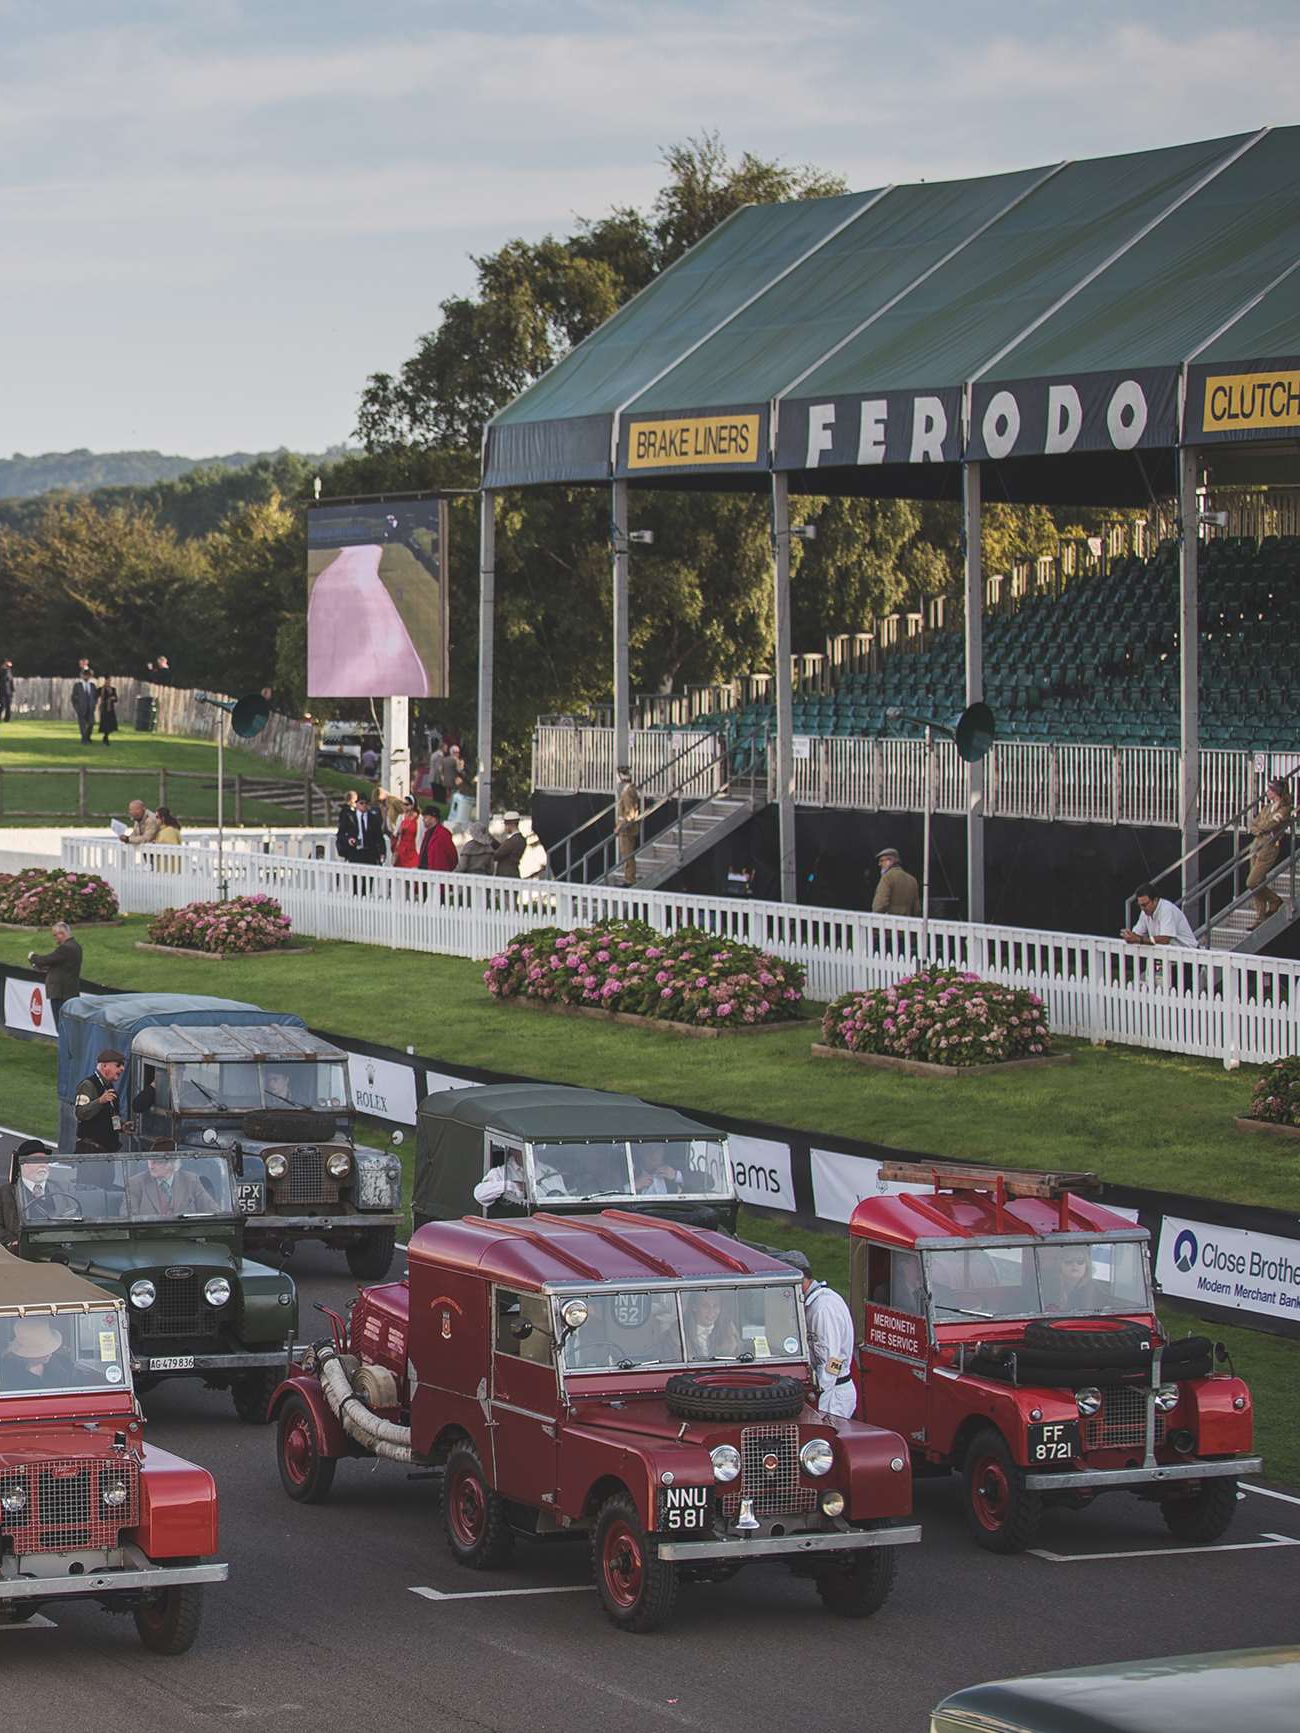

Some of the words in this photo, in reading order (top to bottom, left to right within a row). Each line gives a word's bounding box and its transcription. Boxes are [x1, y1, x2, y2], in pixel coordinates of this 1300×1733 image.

[1211, 381, 1300, 421] CLUTCH
[805, 380, 1149, 469] FERODO
[636, 428, 690, 459] BRAKE
[694, 423, 750, 455] LINERS
[356, 1091, 388, 1112] ROLEX
[1202, 1242, 1246, 1274] Close
[1196, 1276, 1231, 1295] Modern
[1233, 1283, 1277, 1304] Merchant
[873, 1312, 916, 1335] MERIONETH
[870, 1328, 887, 1344] FIRE
[887, 1332, 919, 1353] SERVICE
[1043, 1425, 1064, 1442] FF
[1035, 1442, 1072, 1460] 8721
[666, 1487, 707, 1508] NNU
[668, 1508, 705, 1529] 581
